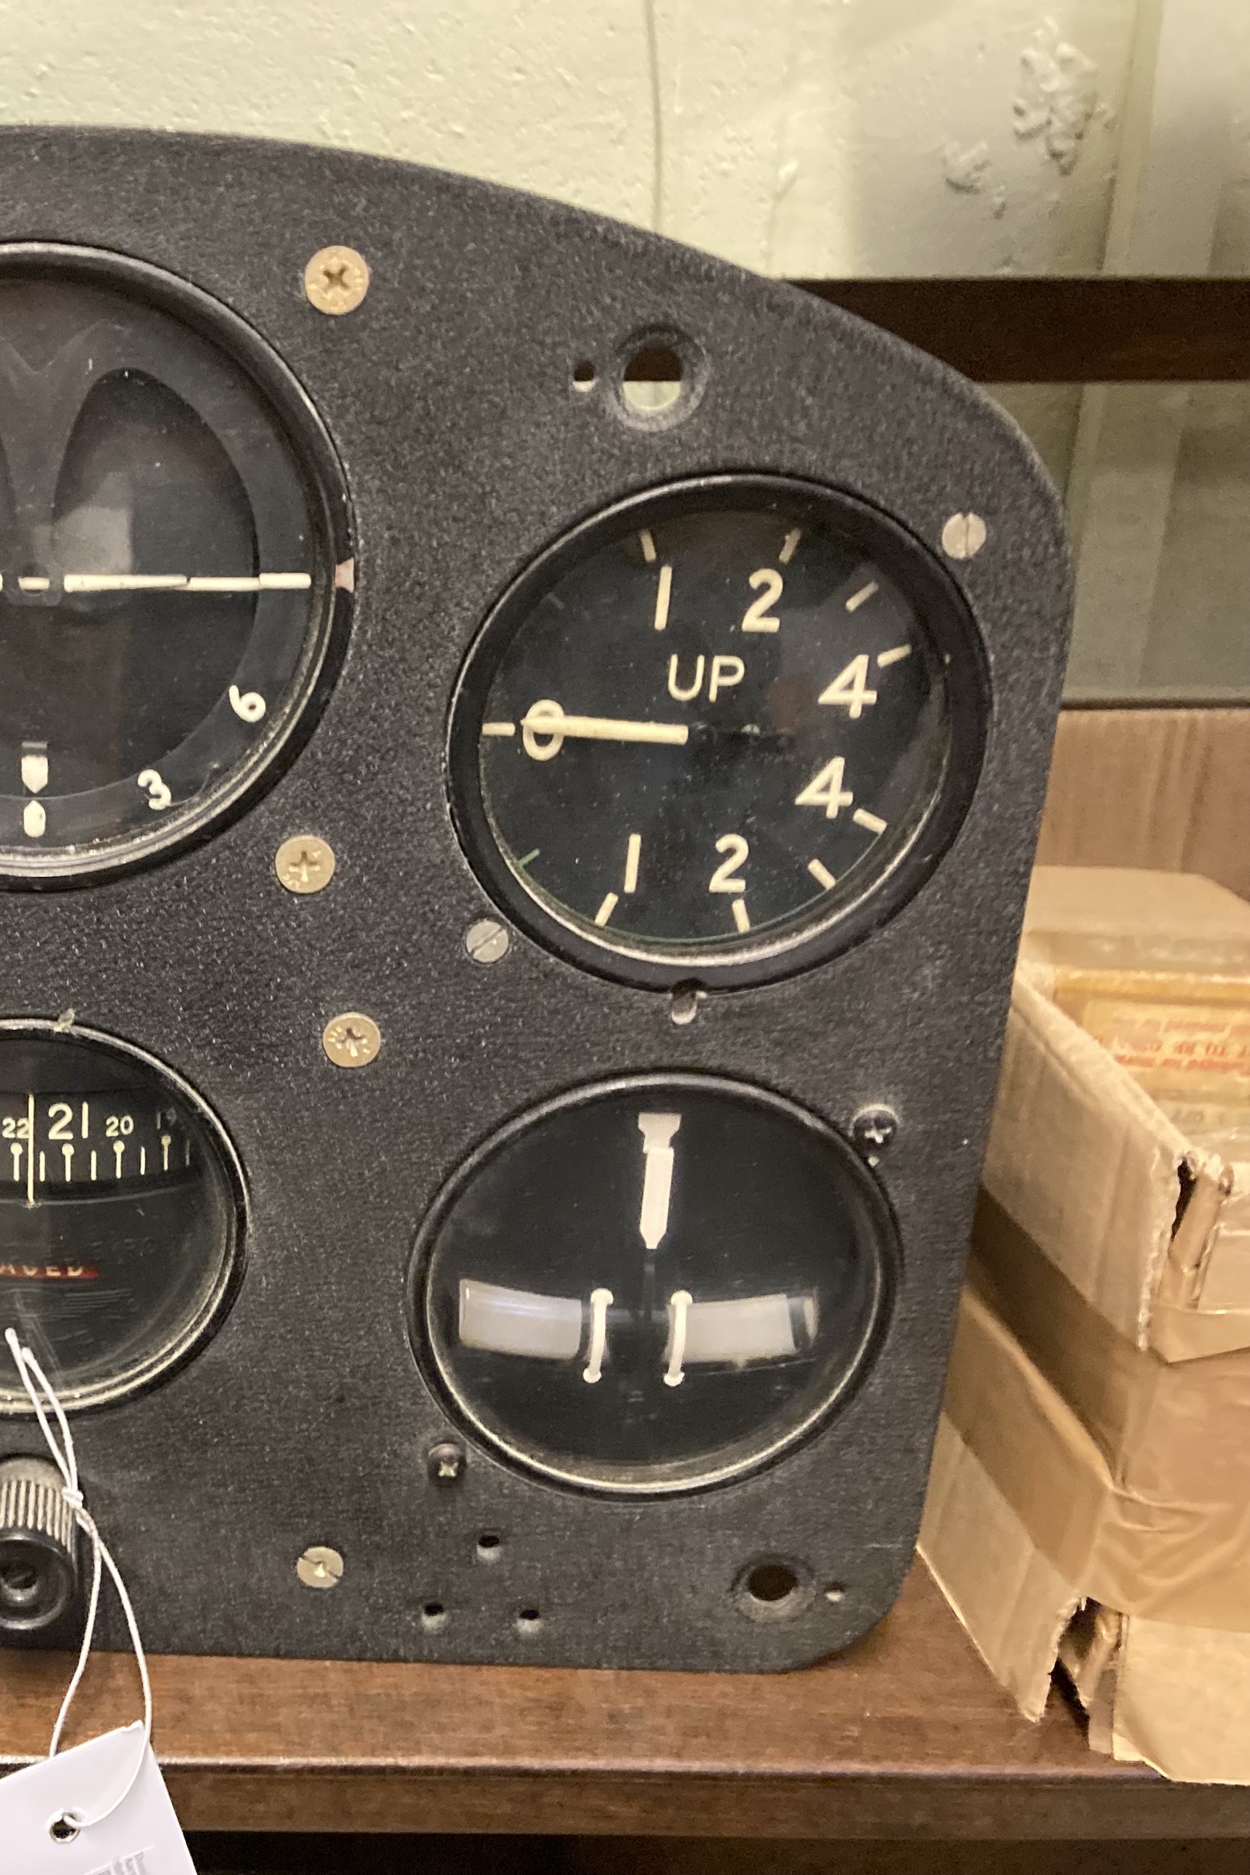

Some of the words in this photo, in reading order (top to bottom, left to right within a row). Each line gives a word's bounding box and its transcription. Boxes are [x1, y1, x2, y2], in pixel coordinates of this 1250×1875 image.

[654, 566, 672, 631] 1
[741, 568, 784, 633] 2
[667, 654, 745, 702] UP
[818, 654, 877, 718] 4
[137, 769, 171, 810] 3
[794, 756, 854, 819] 4
[624, 834, 641, 893] 1
[709, 833, 749, 894] 2
[2, 1117, 30, 1139] 22
[49, 1101, 90, 1140] 21
[105, 1115, 134, 1138] 20
